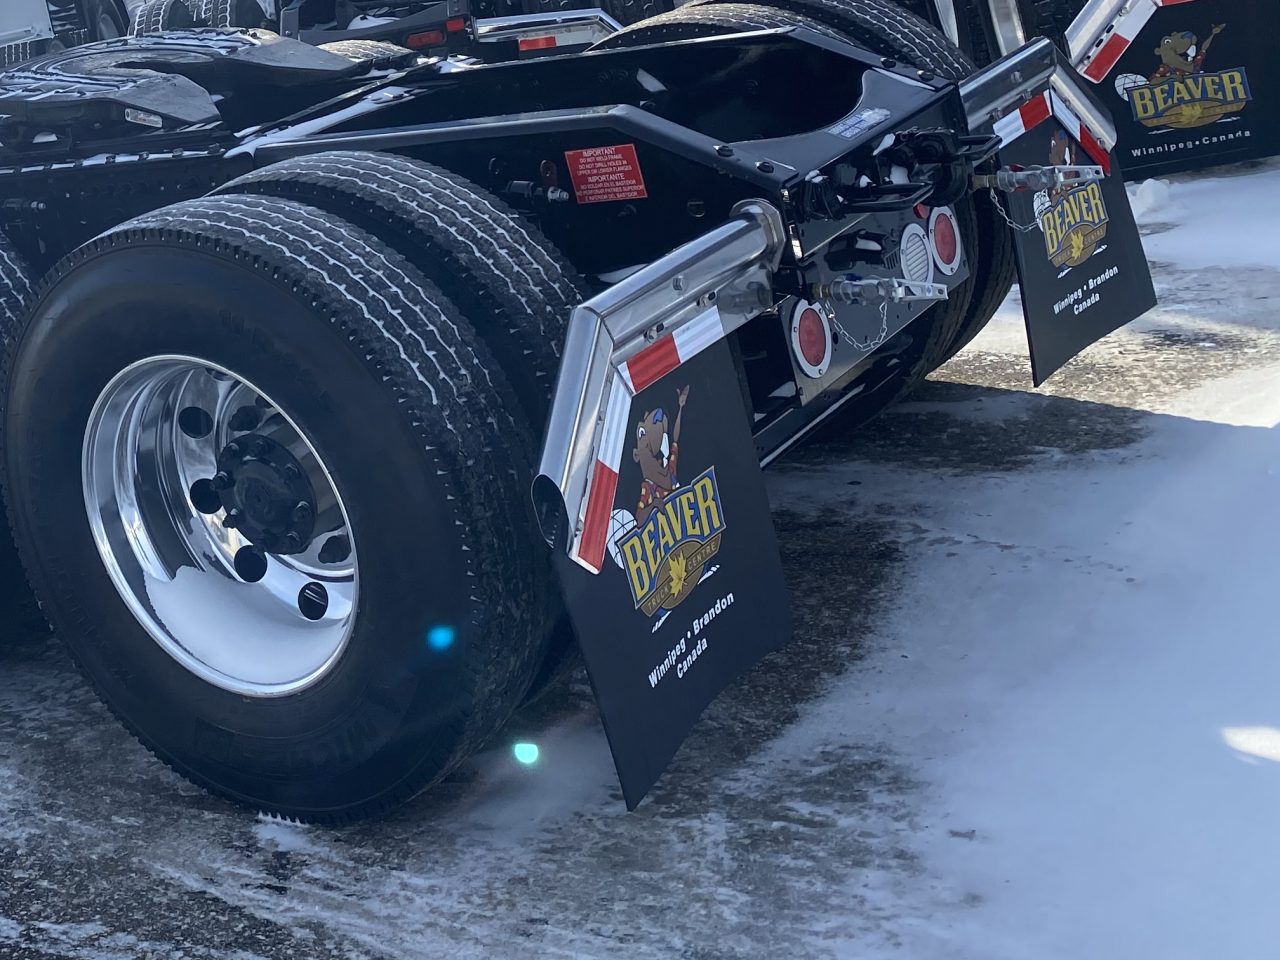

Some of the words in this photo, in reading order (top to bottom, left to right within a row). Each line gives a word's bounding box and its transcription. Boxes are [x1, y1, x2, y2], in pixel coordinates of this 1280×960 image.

[1131, 71, 1247, 119] BEAVER
[582, 148, 616, 157] IMPORTANT
[587, 173, 626, 182] IMPORTANTE
[1043, 183, 1106, 255] BEAVER
[1053, 286, 1083, 315] Winnipeg
[1088, 265, 1119, 290] Brandon
[1073, 292, 1101, 316] Canada
[622, 475, 721, 600] BEAVER
[647, 587, 670, 613] TRUCK
[687, 542, 718, 572] CENTRE
[648, 638, 687, 689] Winnipeg
[693, 592, 735, 635] Brandon
[676, 637, 708, 680] Canada
